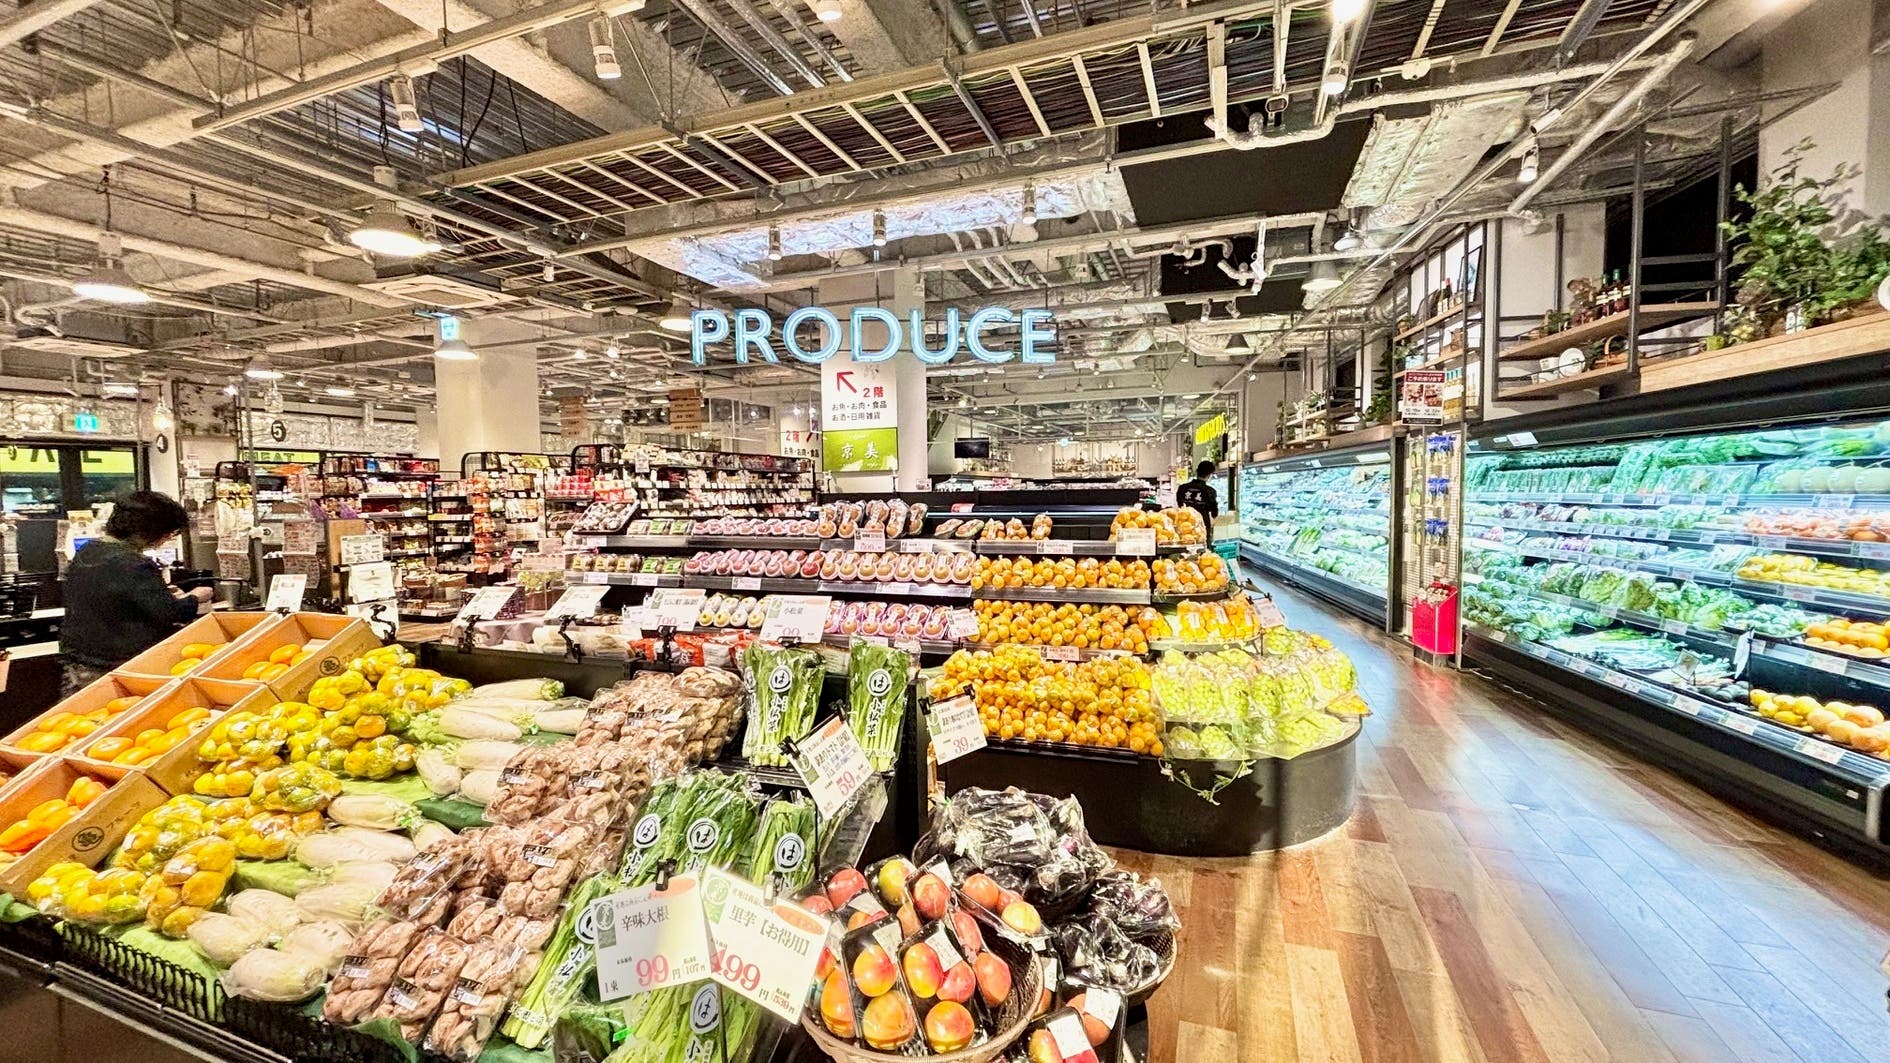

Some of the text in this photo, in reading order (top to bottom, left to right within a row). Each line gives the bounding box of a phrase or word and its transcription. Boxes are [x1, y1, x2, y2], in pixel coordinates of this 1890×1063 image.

[691, 306, 1057, 365] PRODUCE
[863, 386, 884, 398] 2階
[952, 736, 969, 753] 39
[836, 771, 856, 796] 59
[616, 850, 642, 884] 小松
[620, 904, 670, 932] 辛味大根
[636, 954, 669, 987] 99
